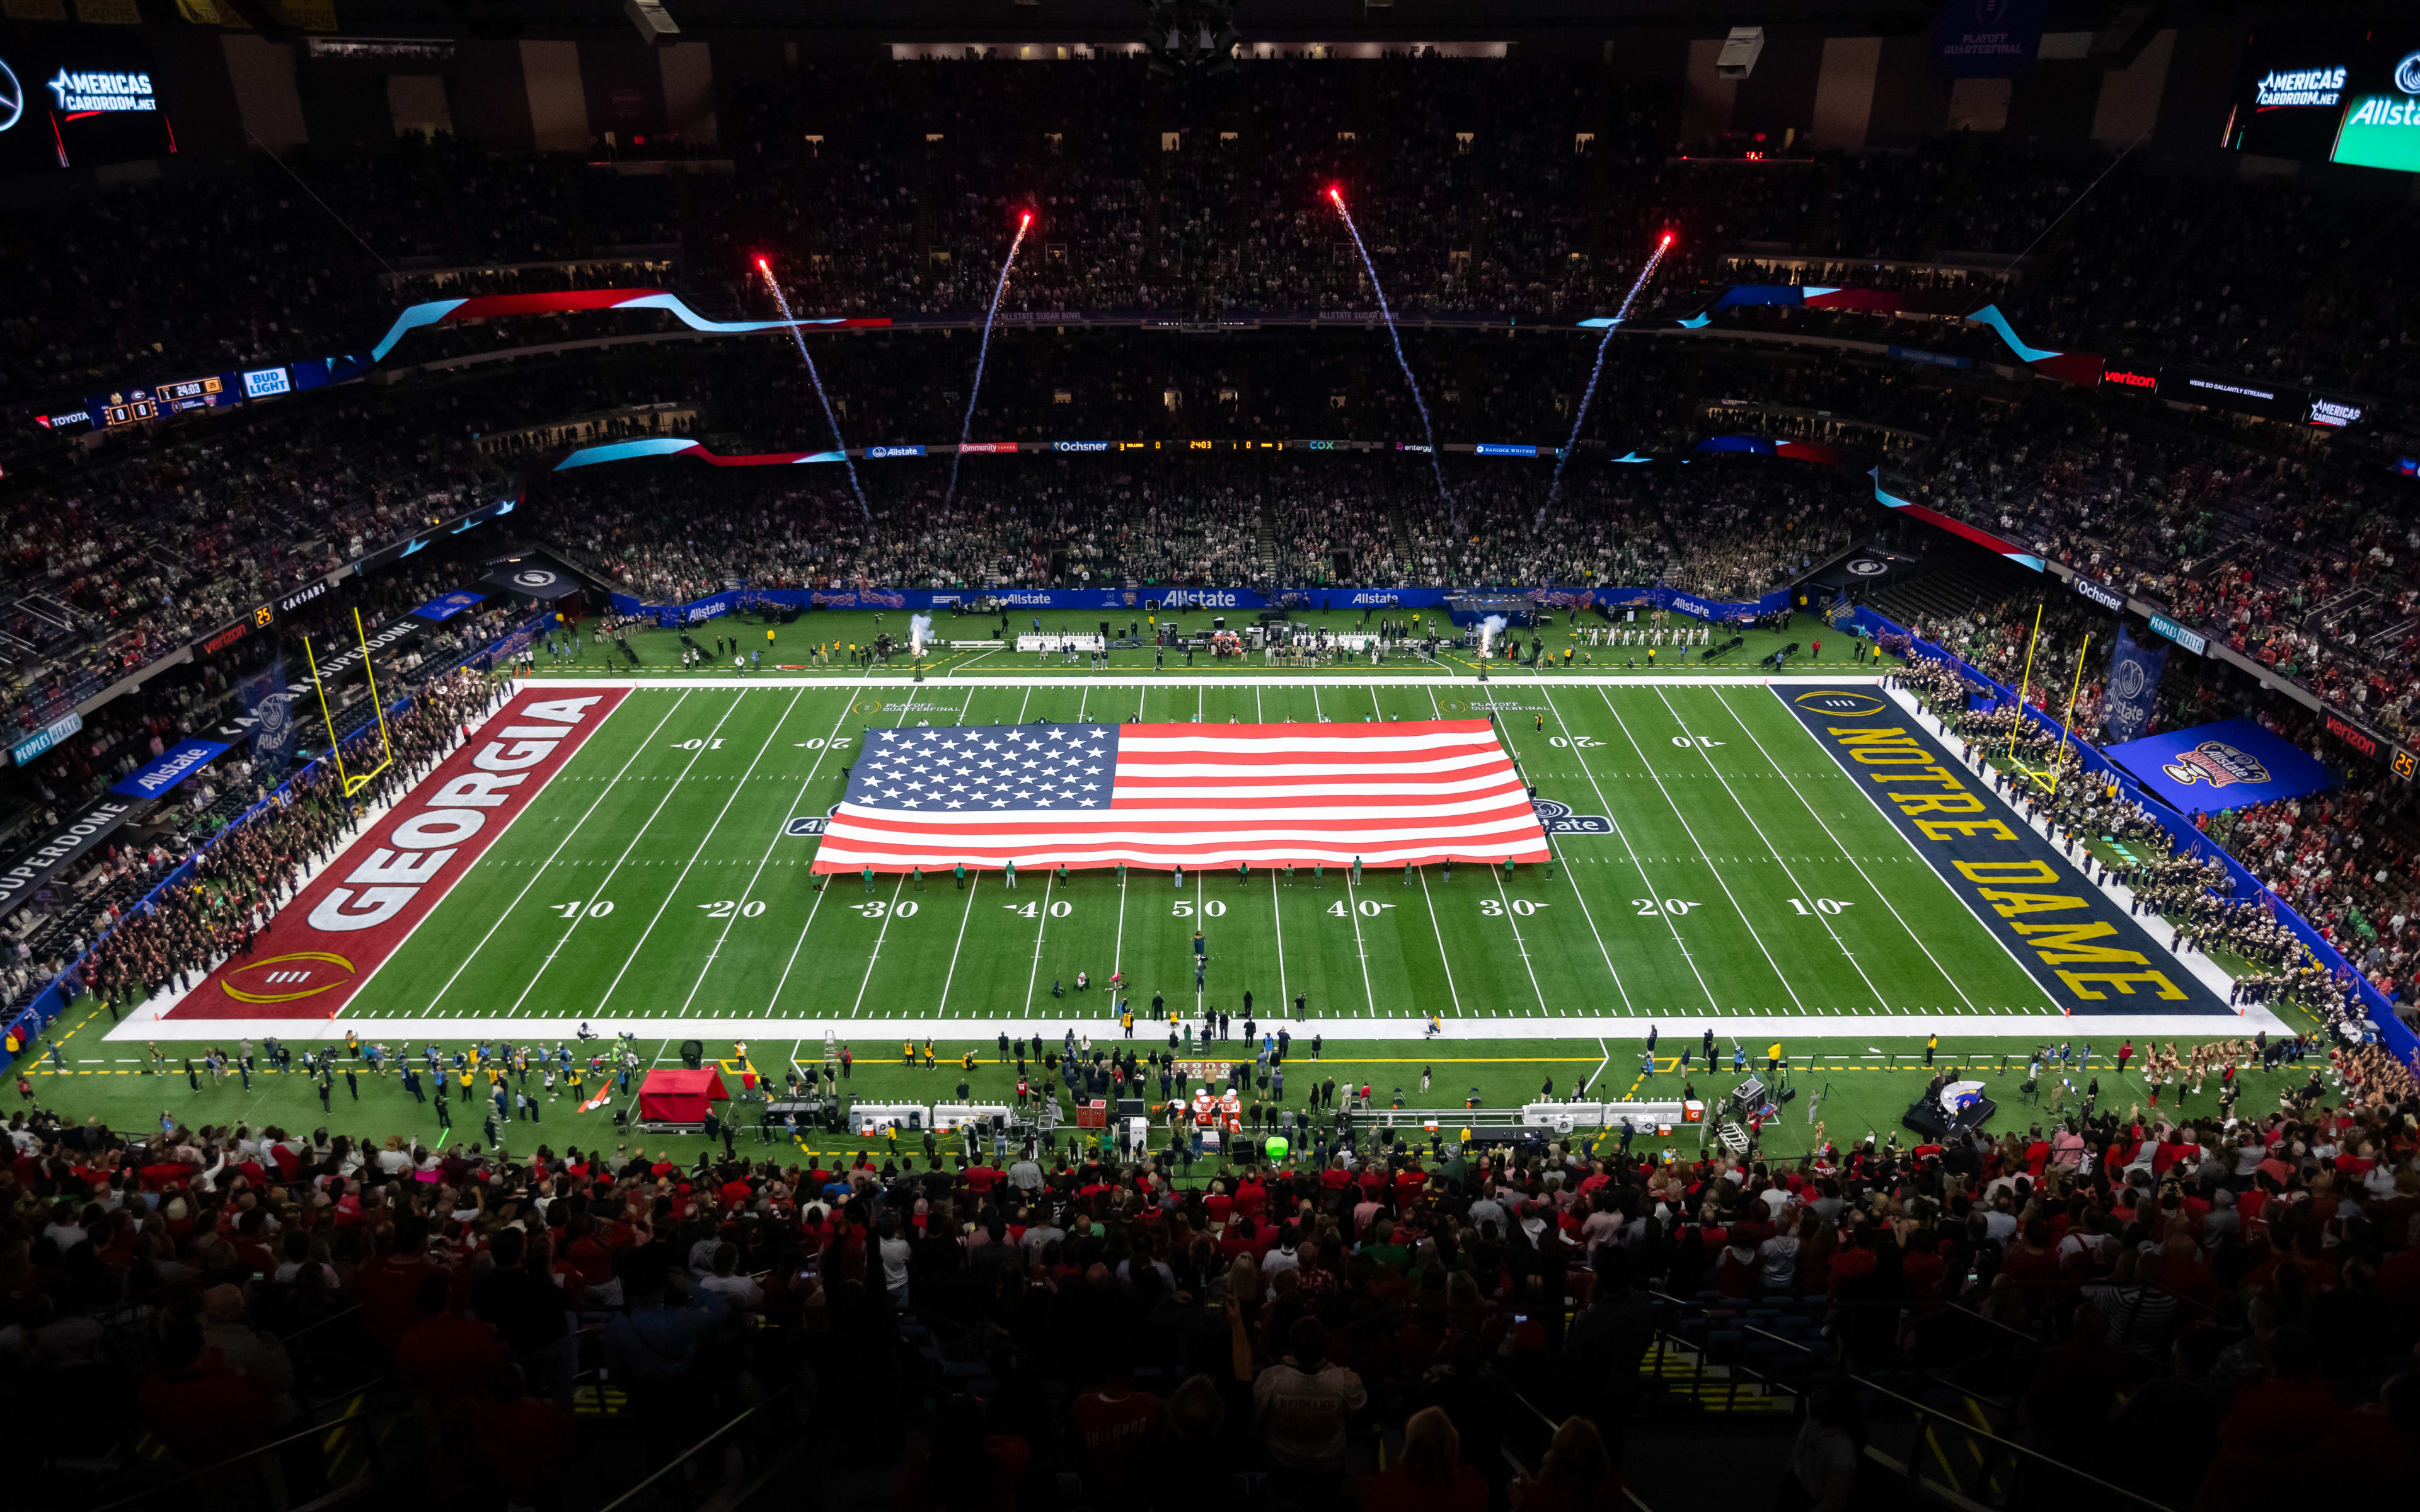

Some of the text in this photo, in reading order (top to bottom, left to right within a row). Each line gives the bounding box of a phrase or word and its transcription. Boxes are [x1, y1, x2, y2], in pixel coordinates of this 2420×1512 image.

[1963, 33, 2008, 44] PLAYOFF
[1944, 43, 2022, 55] QUARTERFINAL
[67, 95, 156, 111] CARDROOM.NET
[2260, 91, 2339, 106] CARDROOM.NET
[1035, 311, 1057, 320] SUGAR
[1060, 311, 1082, 320] BOWL
[1318, 311, 1351, 320] ALLSTATE
[253, 371, 279, 384] BUD
[2105, 370, 2156, 389] verizon
[177, 383, 201, 397] 24:03
[250, 381, 287, 394] LIGHT
[2189, 379, 2205, 387] WERE
[2213, 384, 2244, 395] GALLANTLY
[2244, 389, 2274, 400] STREAMING
[52, 412, 90, 427] TOYOTA
[887, 447, 919, 455] Allstate
[962, 444, 996, 453] Community
[1060, 442, 1107, 452] Ochsner
[1190, 441, 1212, 449] 24:03
[1309, 442, 1335, 450] COX
[1404, 444, 1432, 452] entergy
[282, 583, 326, 611] CAESARS
[1007, 593, 1051, 604] Allstate
[1162, 590, 1236, 607] Allstate
[1352, 593, 1398, 604] Allstate
[2078, 580, 2123, 611] Ochsner
[689, 602, 726, 621] Allstate
[1672, 597, 1709, 618] Allstate
[256, 607, 271, 626] 25
[204, 622, 247, 654] verizon
[2150, 616, 2204, 651] PEOPLES HEALTH
[316, 621, 419, 679] SUPERDOME
[15, 714, 81, 764] PEOPLES HEALTH
[683, 738, 727, 750] 10
[805, 738, 853, 750] 20
[1549, 736, 1596, 748] 20
[1671, 736, 1715, 748] 10
[2326, 715, 2377, 757] verizon
[138, 748, 208, 791] Allstate
[2203, 750, 2249, 777] Allstate
[2395, 752, 2414, 776] 25
[307, 696, 604, 932] GEORGIA
[1827, 727, 2189, 1000] NOTRE DAME
[559, 901, 614, 918] 10
[706, 900, 766, 917] 20
[861, 901, 919, 918] 30
[1017, 901, 1073, 918] 40
[1172, 900, 1227, 917] 50
[1326, 900, 1381, 917] 40
[1479, 899, 1535, 916] 30
[1631, 898, 1689, 915] 20
[1787, 898, 1841, 915] 10
[1197, 1113, 1207, 1122] G
